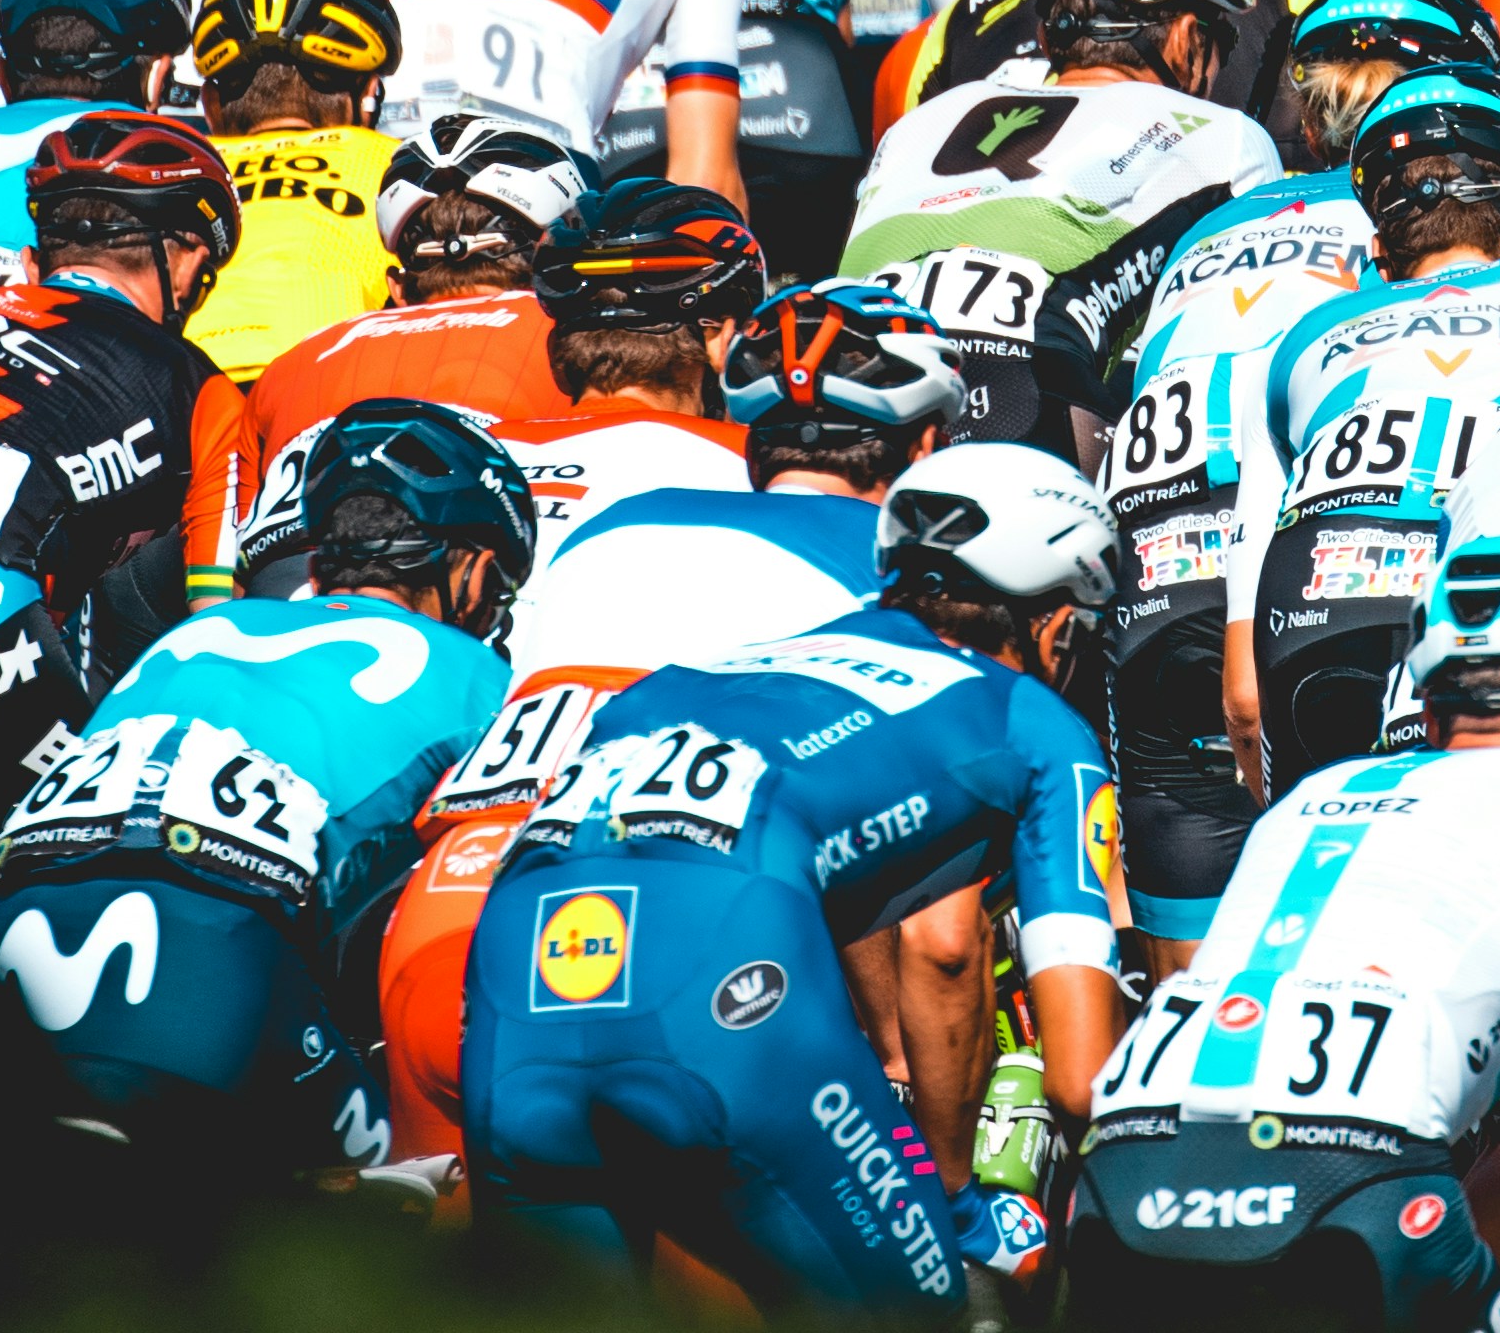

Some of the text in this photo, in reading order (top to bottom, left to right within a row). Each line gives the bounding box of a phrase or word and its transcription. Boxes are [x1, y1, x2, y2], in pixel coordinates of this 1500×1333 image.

[310, 42, 354, 61] LAZER
[482, 23, 545, 102] 91
[1381, 90, 1456, 114] OAKLEY
[612, 127, 656, 150] Nalini
[740, 114, 787, 135] Nalini
[1110, 120, 1168, 176] dimension
[1154, 132, 1183, 153] data
[969, 249, 1003, 261] EISEL
[1177, 225, 1345, 269] ISRAEL CYCLING
[920, 259, 1035, 329] 173
[1323, 315, 1399, 346] ISRAEL
[948, 339, 1032, 359] ONTRÉAL
[56, 418, 164, 503] BMC
[1301, 490, 1399, 519] MONTRÉAL
[1318, 531, 1351, 545] Two
[1408, 532, 1437, 545] On
[1132, 594, 1171, 618] Nalini
[1287, 608, 1329, 628] Nalini
[782, 709, 873, 760] latexco
[25, 741, 121, 814] 62
[633, 730, 734, 801] 26
[211, 755, 290, 844] 62
[1299, 796, 1420, 816] LOPEZ
[626, 823, 735, 854] MONTRÉAL
[199, 837, 308, 894] MONTRÉAL
[1287, 1000, 1394, 1098] 37
[1284, 1126, 1403, 1155] MONTRÉAL
[1182, 1185, 1296, 1229] 21CF
